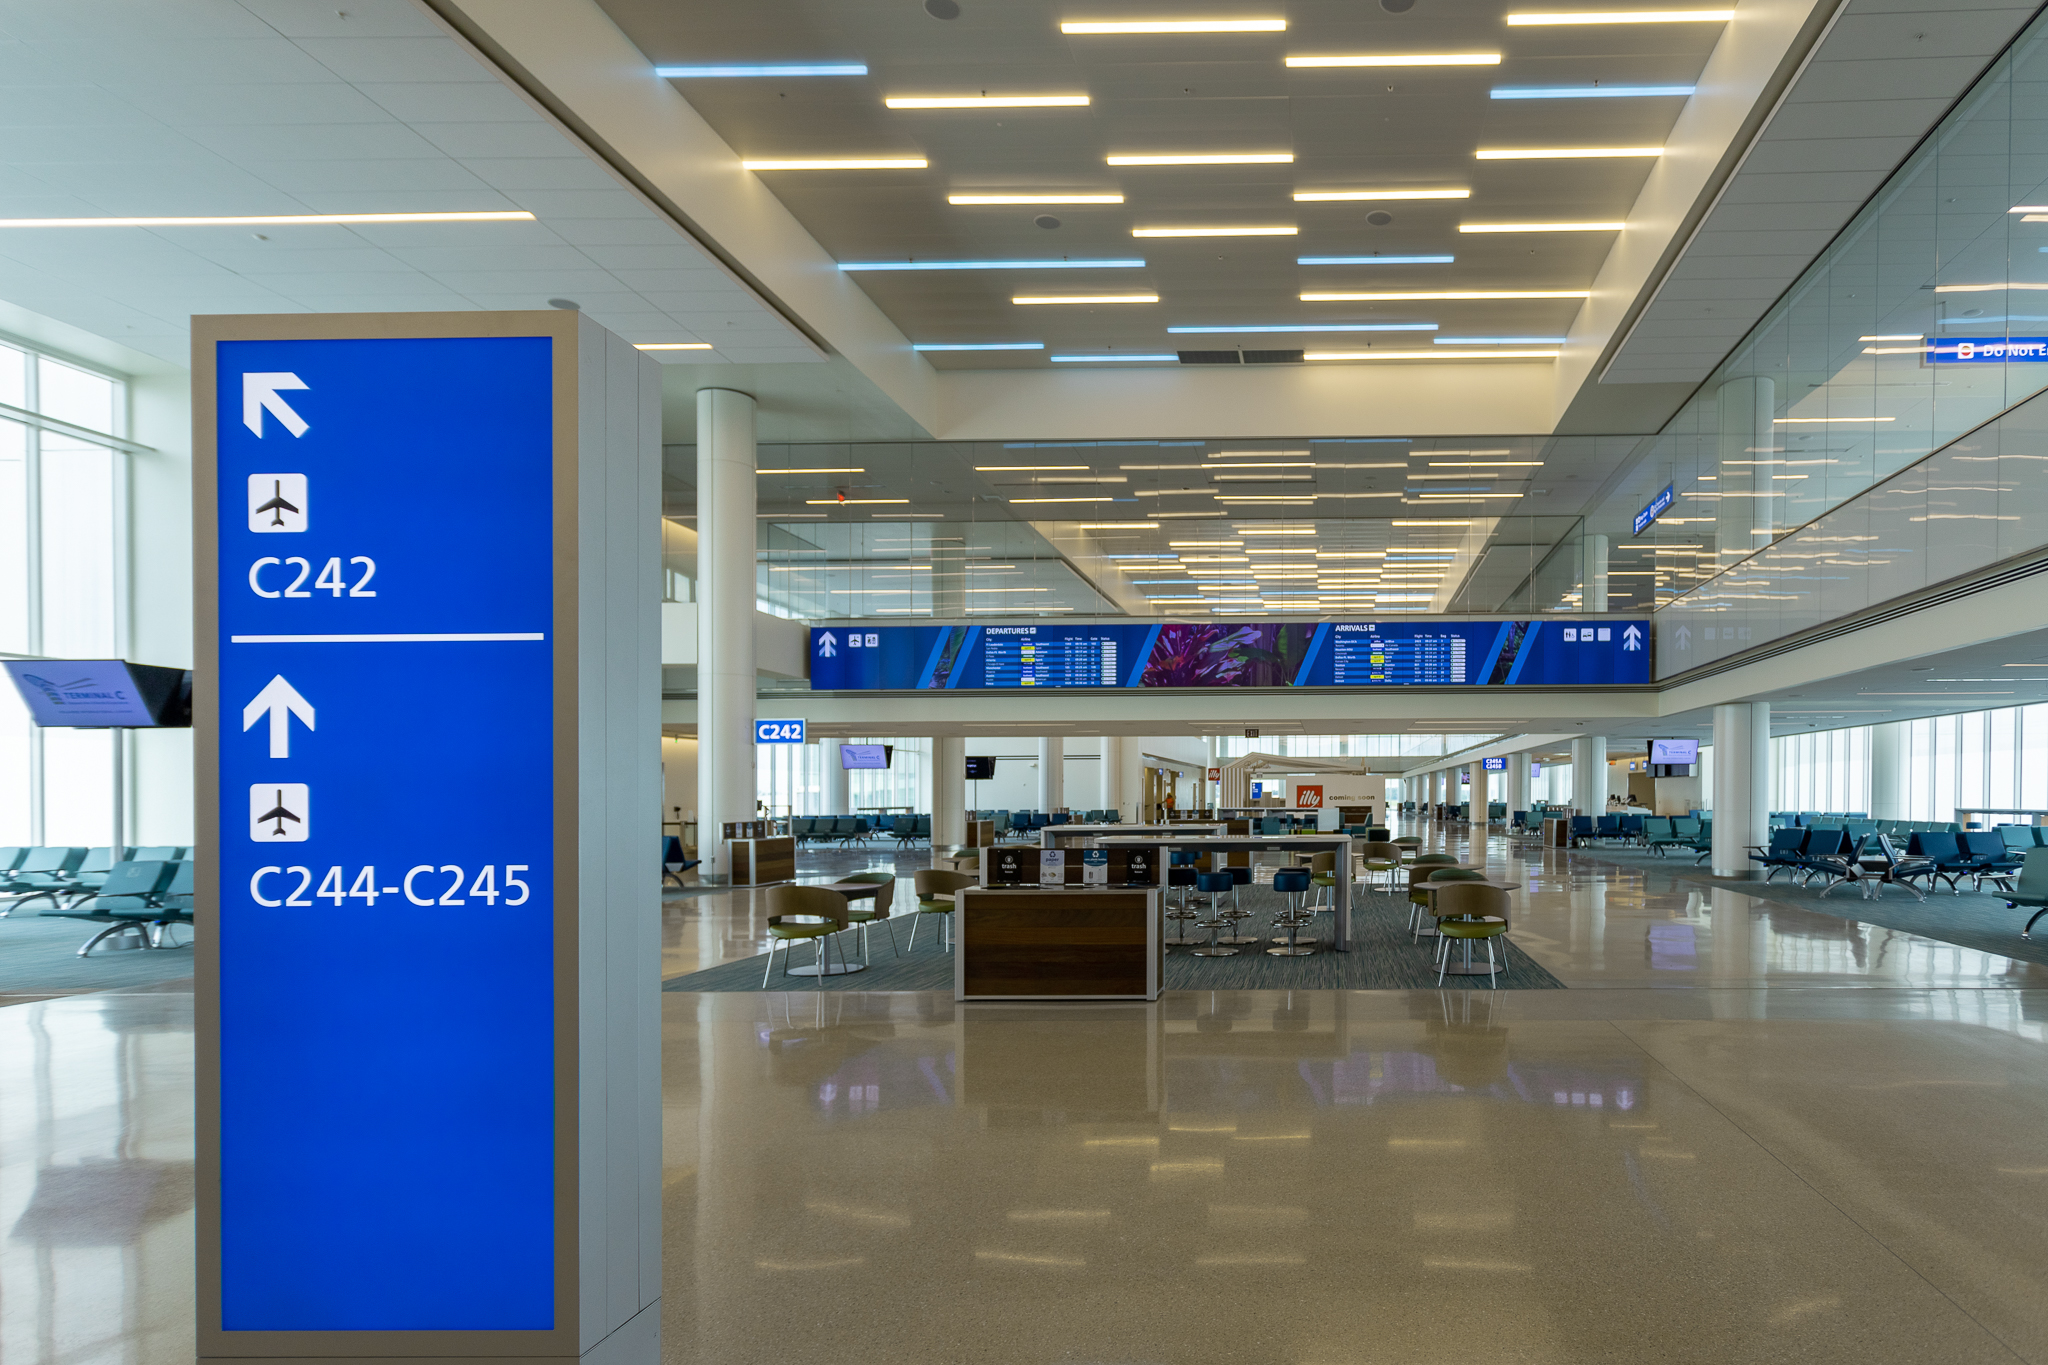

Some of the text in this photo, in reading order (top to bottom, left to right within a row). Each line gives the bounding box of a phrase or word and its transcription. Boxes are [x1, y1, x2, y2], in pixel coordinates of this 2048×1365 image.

[1983, 344, 2004, 357] Do
[2008, 343, 2035, 357] Not
[248, 555, 378, 599] C242
[986, 627, 1029, 635] DEPARTURES
[1335, 624, 1368, 632] ARRIVALS
[63, 690, 126, 700] TERMINAL C
[758, 724, 802, 740] C242
[1208, 769, 1220, 780] illy
[1299, 789, 1321, 808] illy
[1329, 794, 1356, 802] coming
[249, 863, 531, 908] C244-C245
